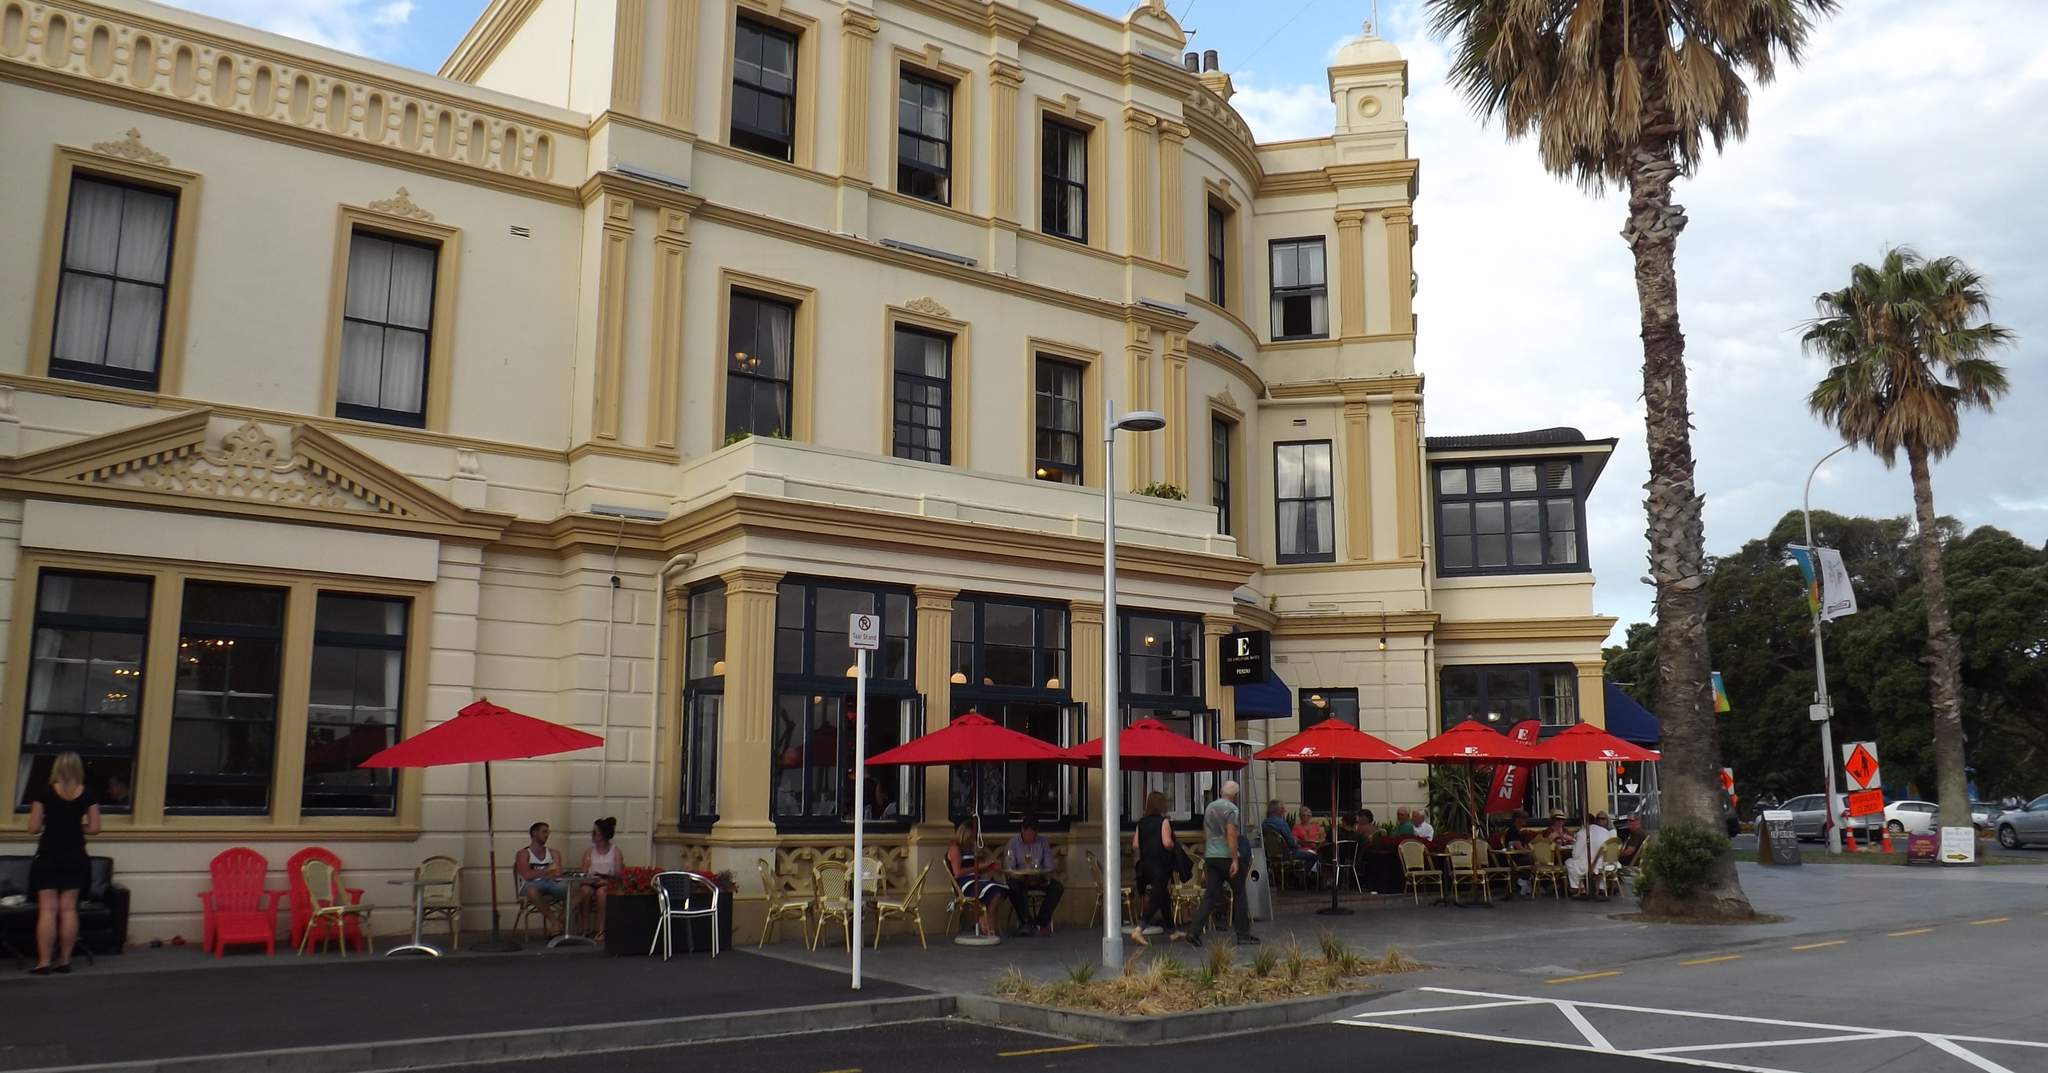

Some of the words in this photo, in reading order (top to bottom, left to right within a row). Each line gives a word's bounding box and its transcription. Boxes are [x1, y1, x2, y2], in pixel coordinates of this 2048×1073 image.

[1237, 637, 1249, 656] E
[1517, 728, 1529, 741] E
[1499, 764, 1518, 800] PEN
